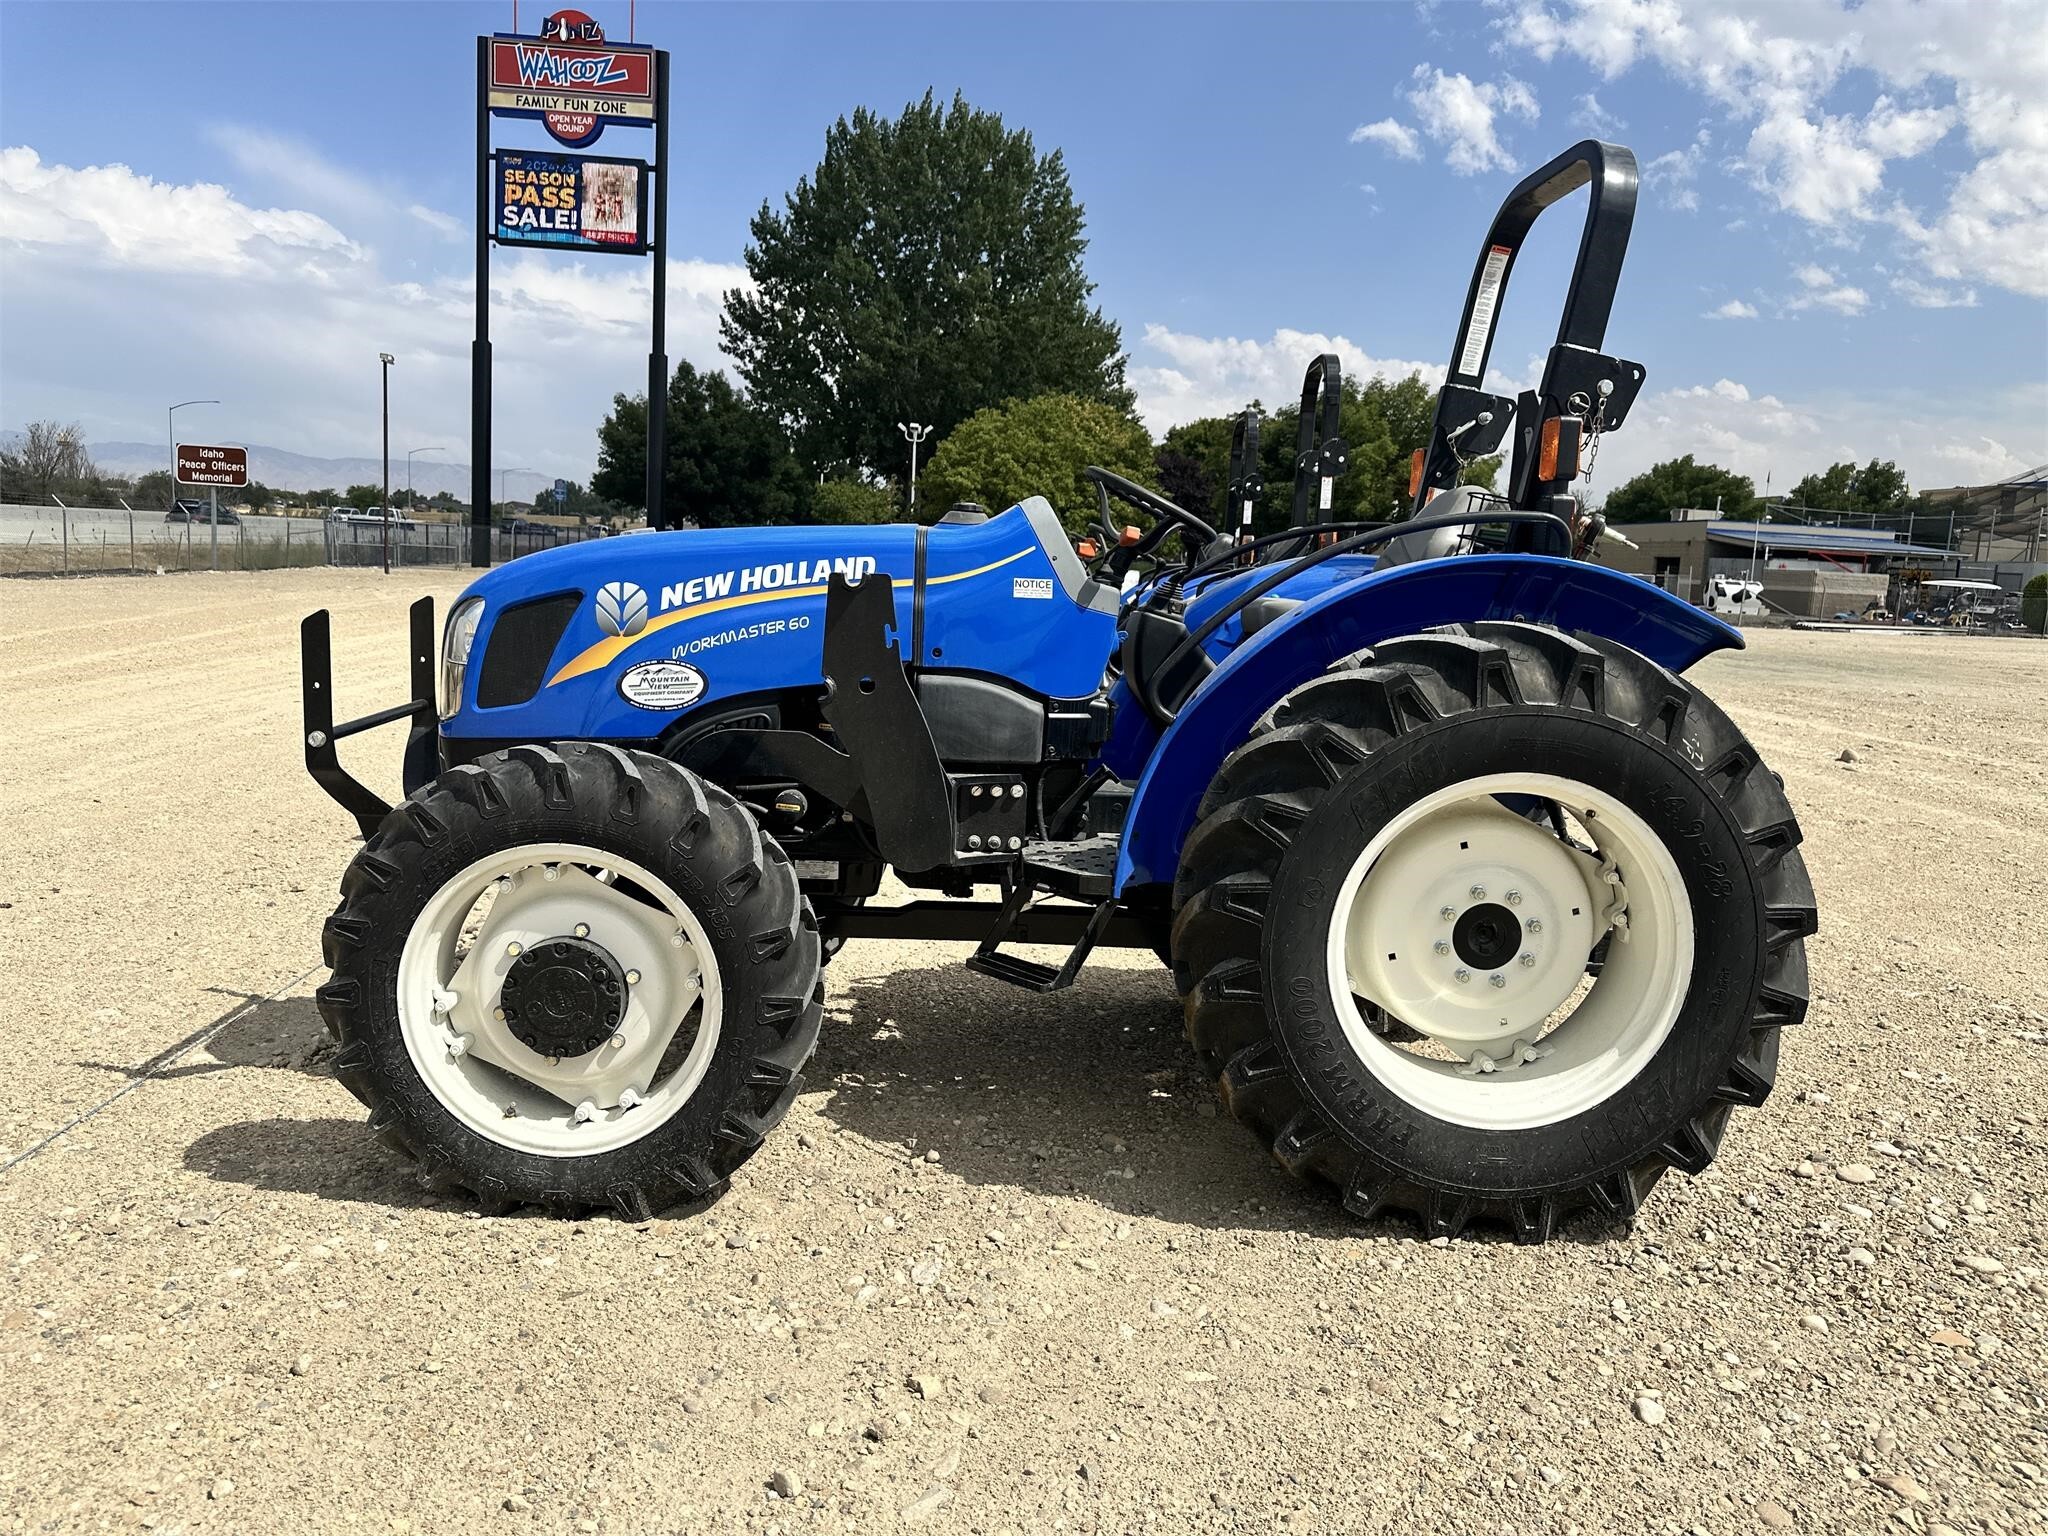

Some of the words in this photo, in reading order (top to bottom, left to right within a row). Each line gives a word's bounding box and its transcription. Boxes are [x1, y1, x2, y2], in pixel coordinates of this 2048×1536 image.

[541, 17, 601, 42] PINZ
[515, 42, 629, 90] WAHOOZ
[516, 95, 560, 109] FAMILY
[564, 98, 589, 112] FUN
[594, 100, 627, 114] ZONE
[549, 114, 570, 124] OPEN
[571, 116, 593, 126] YEAR
[557, 124, 585, 133] ROUND
[504, 169, 576, 187] SEASON
[504, 183, 576, 209] PASS
[503, 205, 578, 230] SALE!
[199, 448, 225, 459] Idaho
[179, 459, 206, 469] Peace
[211, 460, 245, 472] Officers
[192, 471, 233, 483] Memorial
[660, 570, 735, 611] NEW
[740, 556, 876, 592] HOLLAND
[1014, 579, 1051, 589] NOTICE
[671, 620, 786, 660] WORKMASTER
[788, 616, 810, 630] 60
[640, 676, 690, 686] MOUNTAIN
[1288, 976, 1337, 1060] 2000
